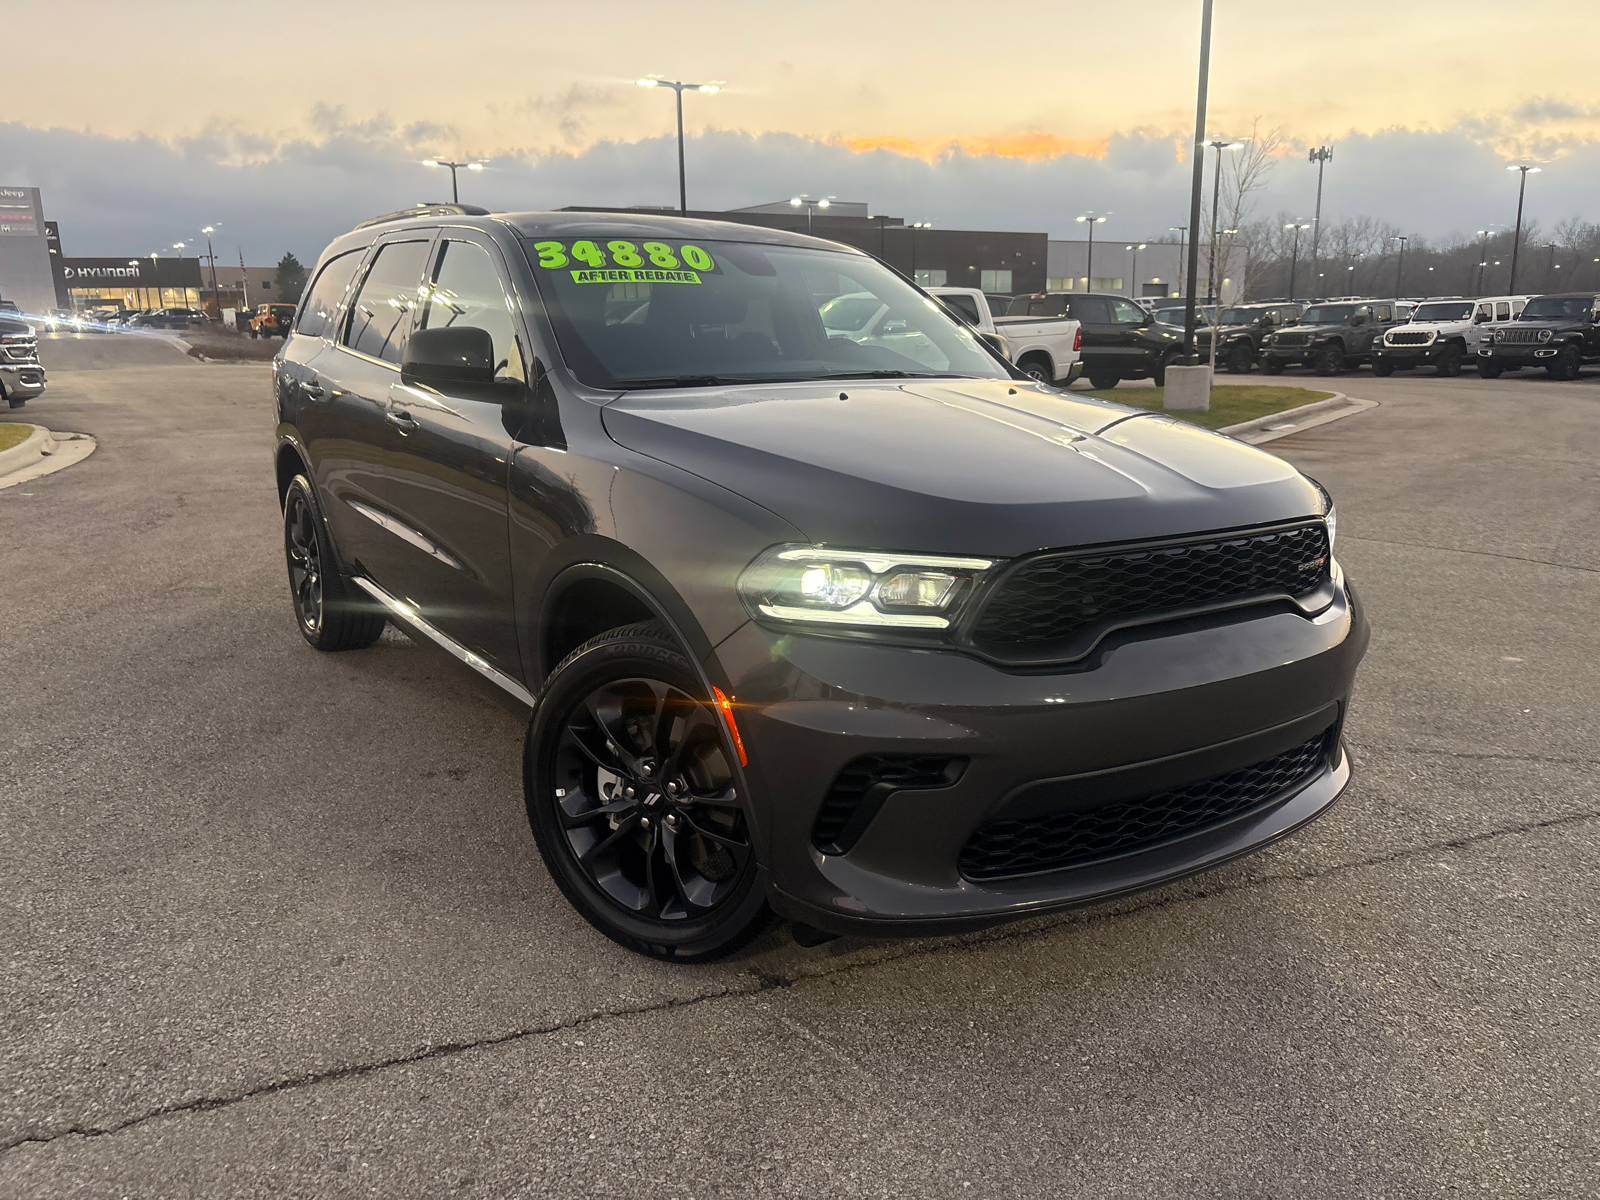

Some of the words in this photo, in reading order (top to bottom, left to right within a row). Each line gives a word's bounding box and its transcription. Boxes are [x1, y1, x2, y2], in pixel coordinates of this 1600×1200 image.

[0, 189, 24, 198] Jeep
[533, 240, 715, 271] 34880
[77, 267, 140, 277] HYUNDAI
[577, 270, 631, 281] AFTER
[634, 271, 696, 282] REBATE
